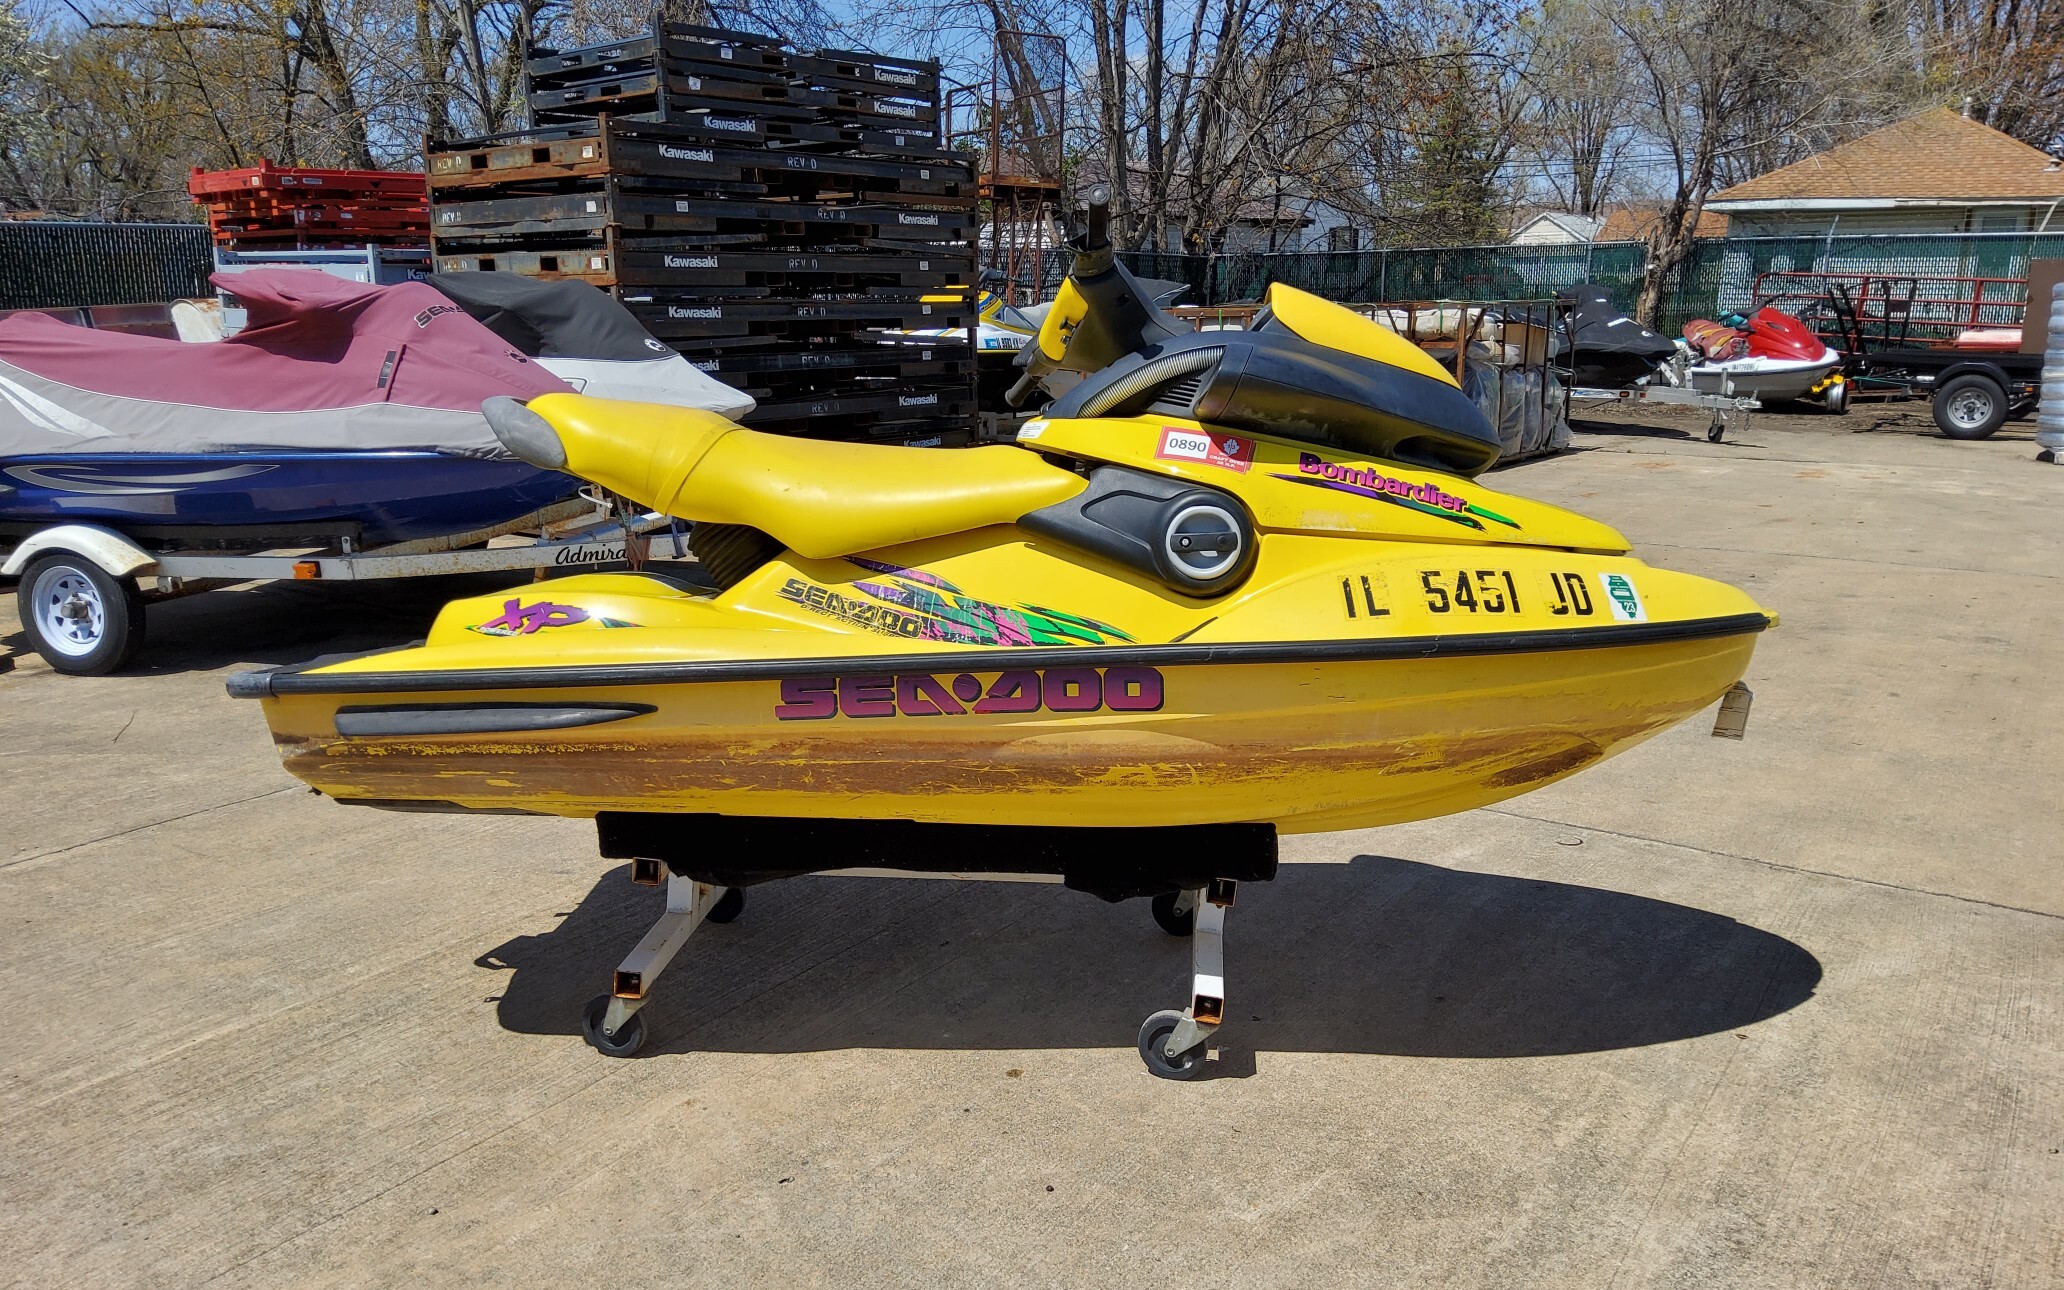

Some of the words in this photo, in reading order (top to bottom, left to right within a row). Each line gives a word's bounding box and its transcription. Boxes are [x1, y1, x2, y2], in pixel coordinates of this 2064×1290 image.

[874, 69, 916, 85] Kawasaki
[873, 101, 916, 117] Kawasaki
[703, 115, 756, 133] Kawasaki
[658, 143, 714, 162] Kawasaki
[787, 157, 807, 168] REV
[811, 159, 817, 169] D
[898, 213, 939, 226] Kawasaki
[664, 255, 718, 269] Kawasaki
[788, 259, 807, 270] REV
[668, 306, 722, 319] Kawasaki
[797, 307, 815, 317] REV
[898, 393, 938, 407] Kawasaki
[811, 402, 829, 414] REV
[903, 435, 942, 448] Kawasaki
[1168, 437, 1207, 453] 0890
[1298, 451, 1468, 513] Bombardier
[555, 543, 629, 565] Admira
[1341, 574, 1391, 619] IL
[1420, 569, 1522, 613] 5451
[1623, 601, 1636, 613] 23
